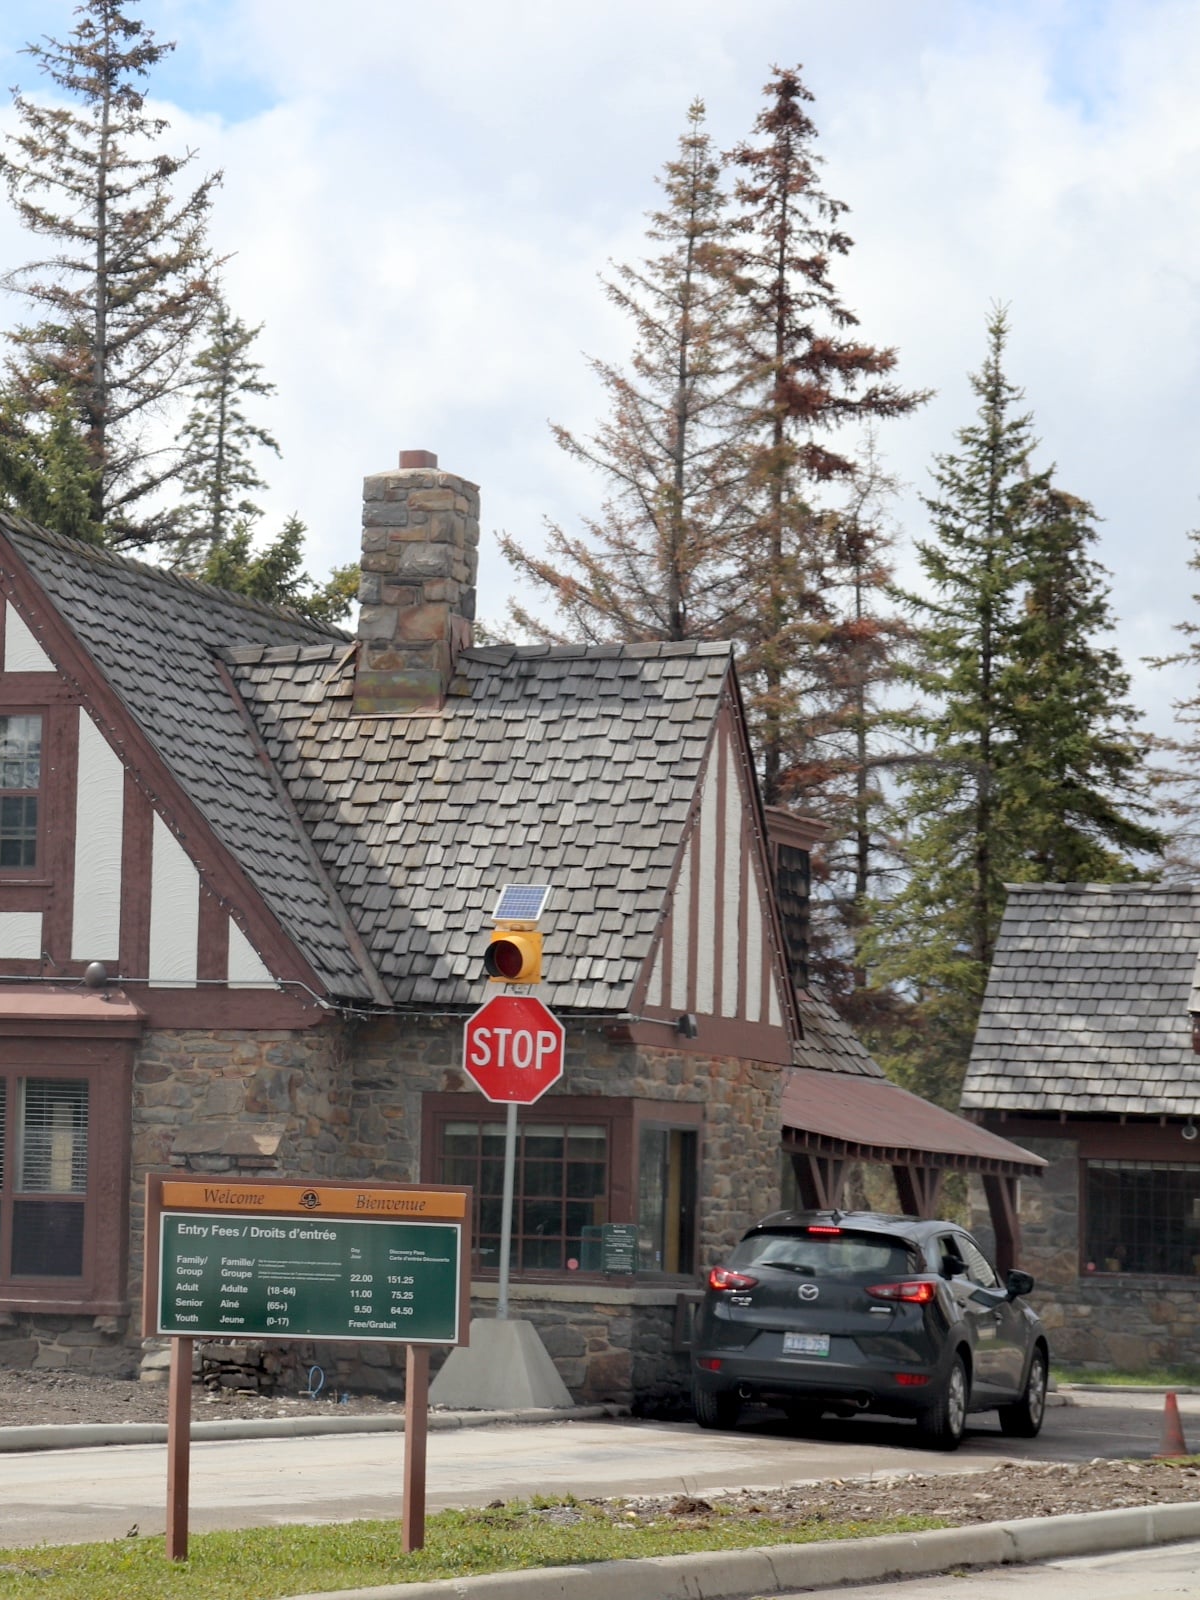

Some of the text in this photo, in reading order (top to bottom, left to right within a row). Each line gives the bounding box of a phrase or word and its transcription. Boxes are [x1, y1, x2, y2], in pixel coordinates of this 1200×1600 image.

[471, 1027, 557, 1070] STOP
[203, 1188, 265, 1205] Welcome
[356, 1194, 426, 1211] Bienvenue
[177, 1223, 337, 1241] Entry Fees / Droits d'entrée
[176, 1255, 208, 1266] Family/
[221, 1257, 256, 1267] Famille/
[176, 1267, 203, 1277] Group
[221, 1269, 253, 1279] Groupe
[350, 1274, 373, 1283] 22.00
[387, 1275, 414, 1284] 151.25
[175, 1283, 296, 1297] Adult Adulte (18-64)
[350, 1290, 414, 1300] 11.00 75.25
[175, 1298, 204, 1307] Senior
[266, 1301, 288, 1312] (65+)
[354, 1305, 413, 1315] 9.50 64.50
[175, 1313, 290, 1327] Youth Jeune (0-17)
[348, 1320, 397, 1330] Free/Gratuit
